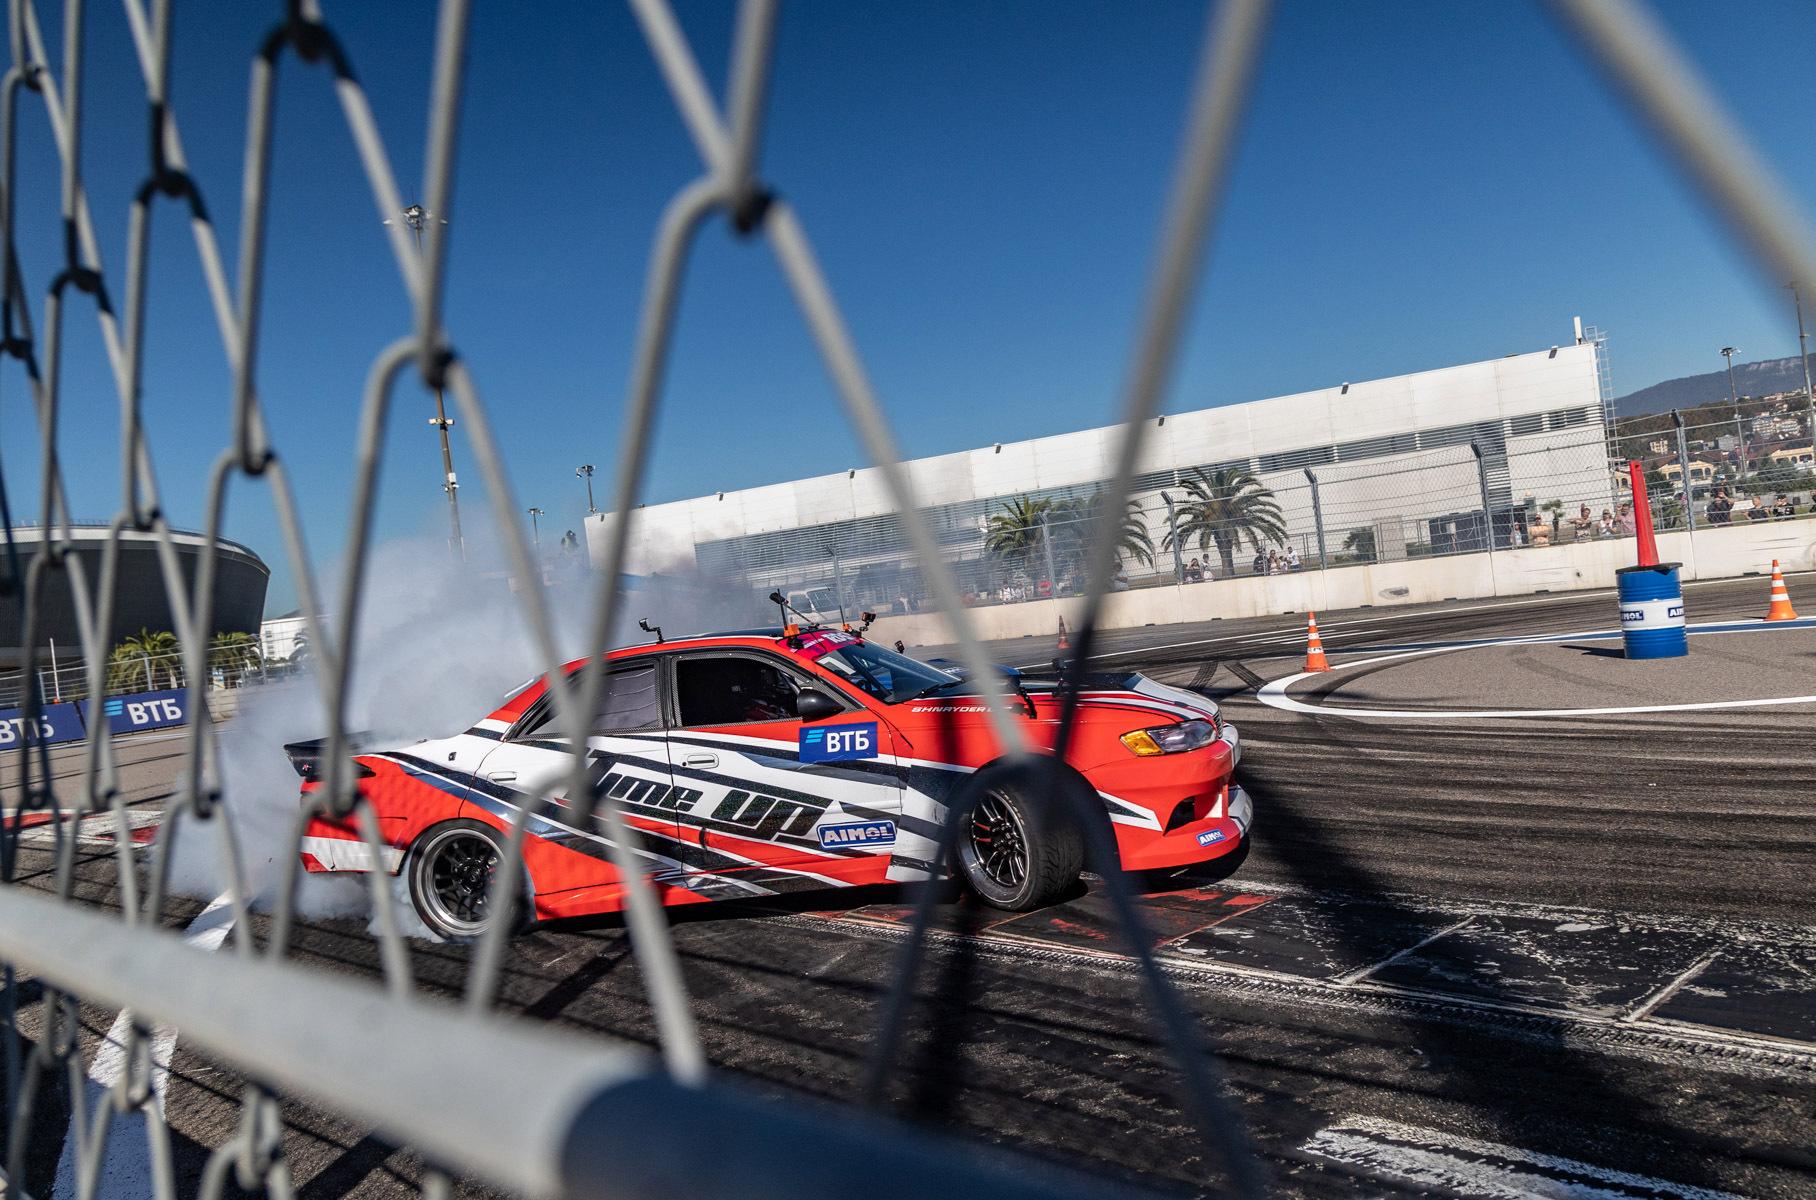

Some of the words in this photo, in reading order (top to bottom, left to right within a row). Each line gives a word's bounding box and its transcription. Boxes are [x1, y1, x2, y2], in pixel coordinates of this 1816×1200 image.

[127, 698, 183, 725] ВТБ
[826, 729, 870, 753] ВТБ
[824, 827, 895, 844] AIMOL
